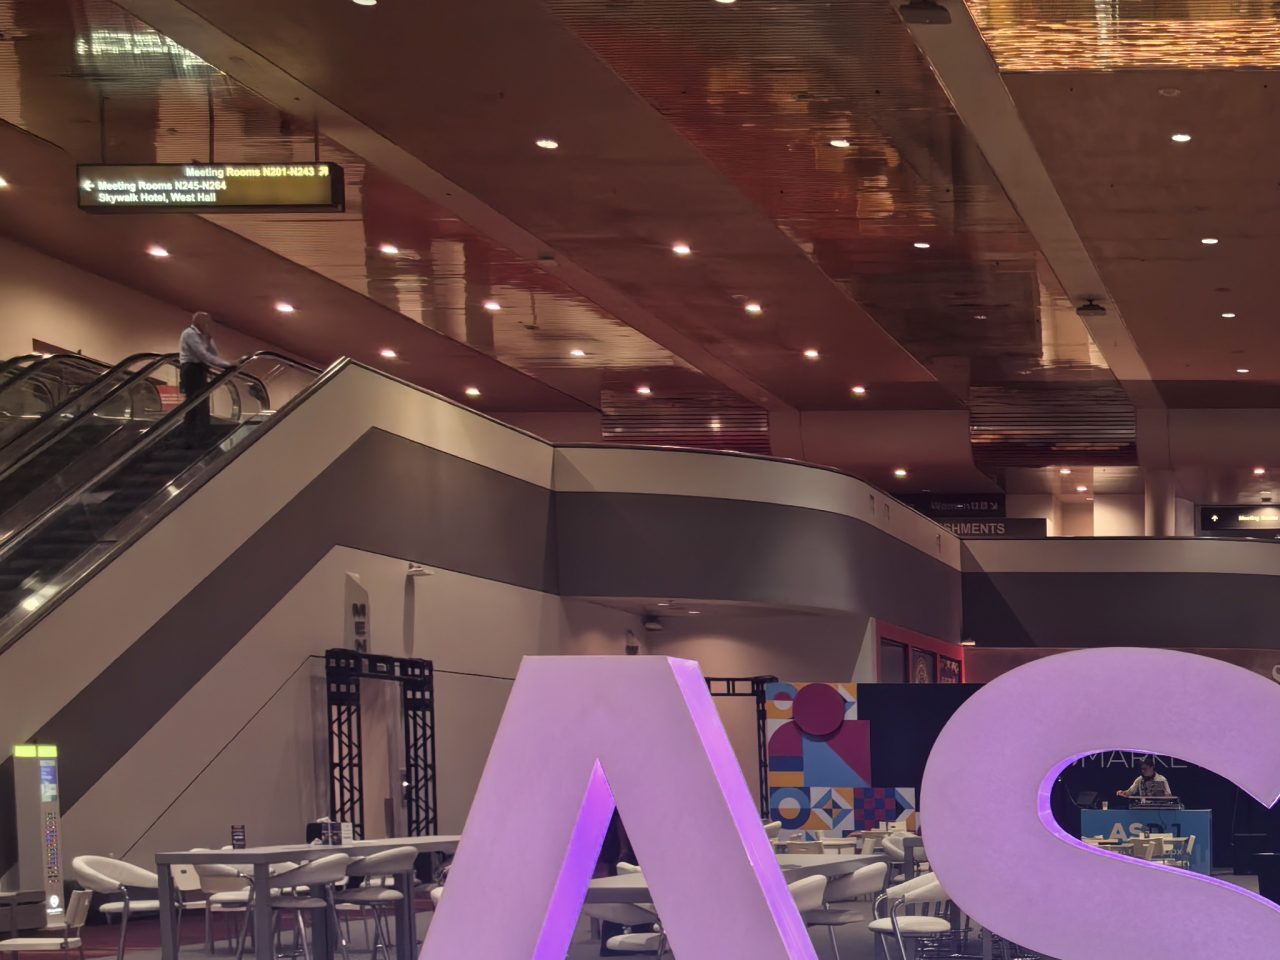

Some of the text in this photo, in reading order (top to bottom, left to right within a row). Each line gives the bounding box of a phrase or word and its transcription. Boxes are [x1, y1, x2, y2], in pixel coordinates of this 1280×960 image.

[186, 166, 314, 178] Meeting Rooms N201-N243
[98, 181, 227, 192] Meeting Rooms N245-N264
[99, 192, 216, 203] Skywalk Hotel, West Hall
